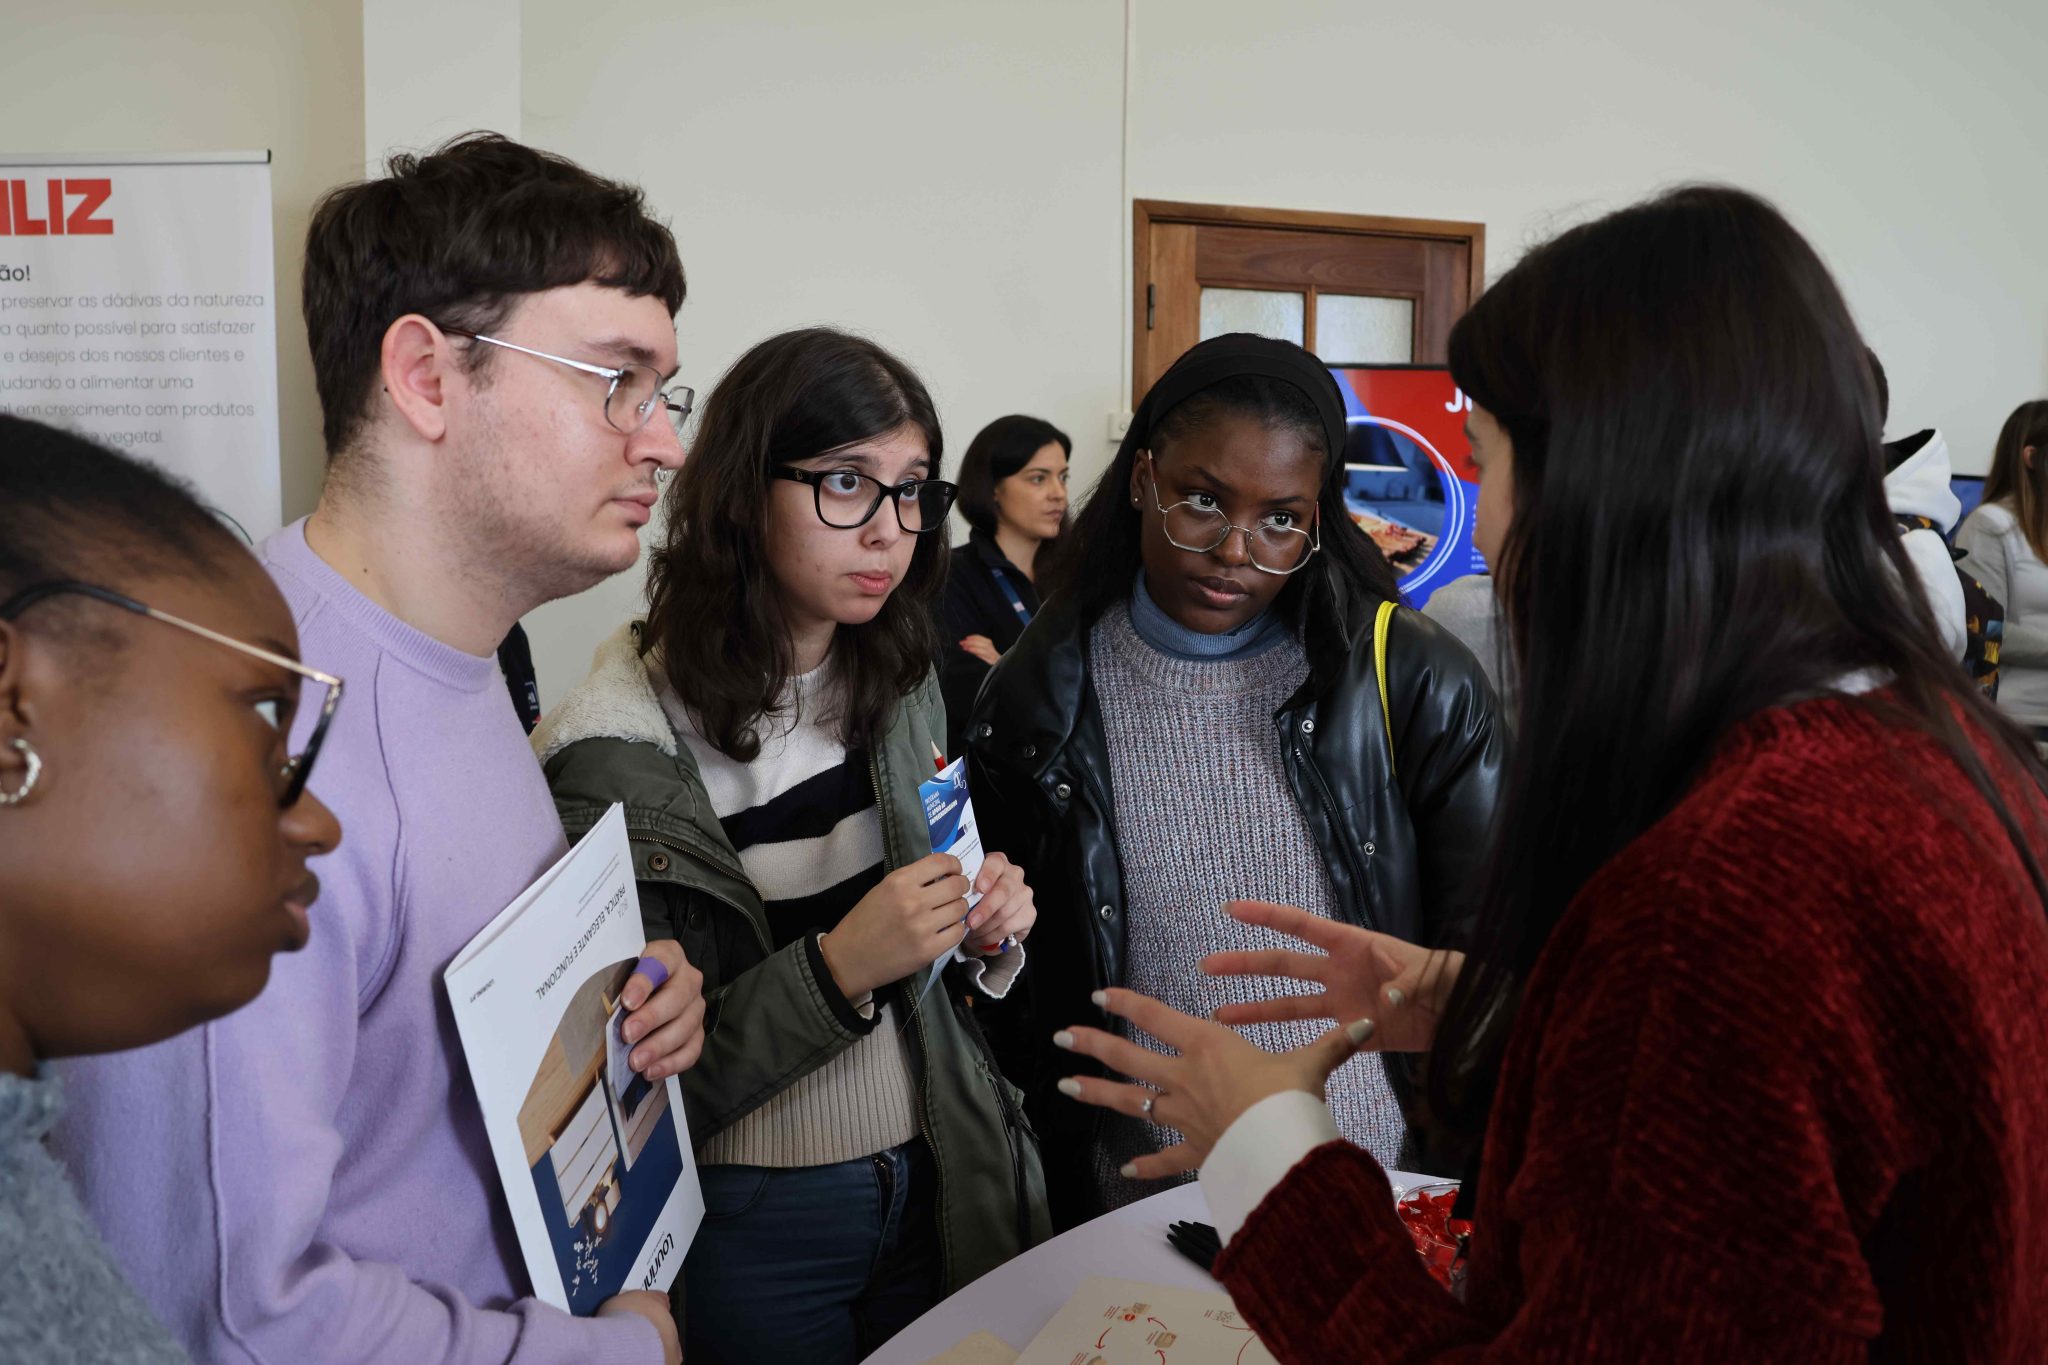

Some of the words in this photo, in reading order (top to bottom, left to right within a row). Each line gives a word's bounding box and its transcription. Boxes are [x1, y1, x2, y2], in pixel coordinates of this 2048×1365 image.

[1, 296, 73, 312] preservar
[78, 296, 98, 308] as
[167, 292, 190, 308] da
[193, 292, 264, 308] natureza
[16, 321, 71, 340] quanto
[74, 320, 137, 340] possível
[140, 322, 176, 339] para
[181, 320, 256, 336] satisfazer
[3, 351, 15, 363] e
[19, 347, 76, 367] desejos
[80, 347, 109, 362] dos
[114, 350, 165, 363] nossos
[169, 347, 230, 362] clientes
[234, 350, 245, 362] e
[65, 377, 76, 390] a
[80, 374, 154, 390] alimentar
[159, 376, 193, 390] uma
[16, 405, 41, 417] em
[45, 403, 142, 417] crescimento
[145, 404, 178, 417] com
[182, 401, 255, 420] produtos
[578, 911, 606, 951] ELEGANTE
[572, 945, 579, 959] E
[535, 950, 574, 1000] FUNCIONAL
